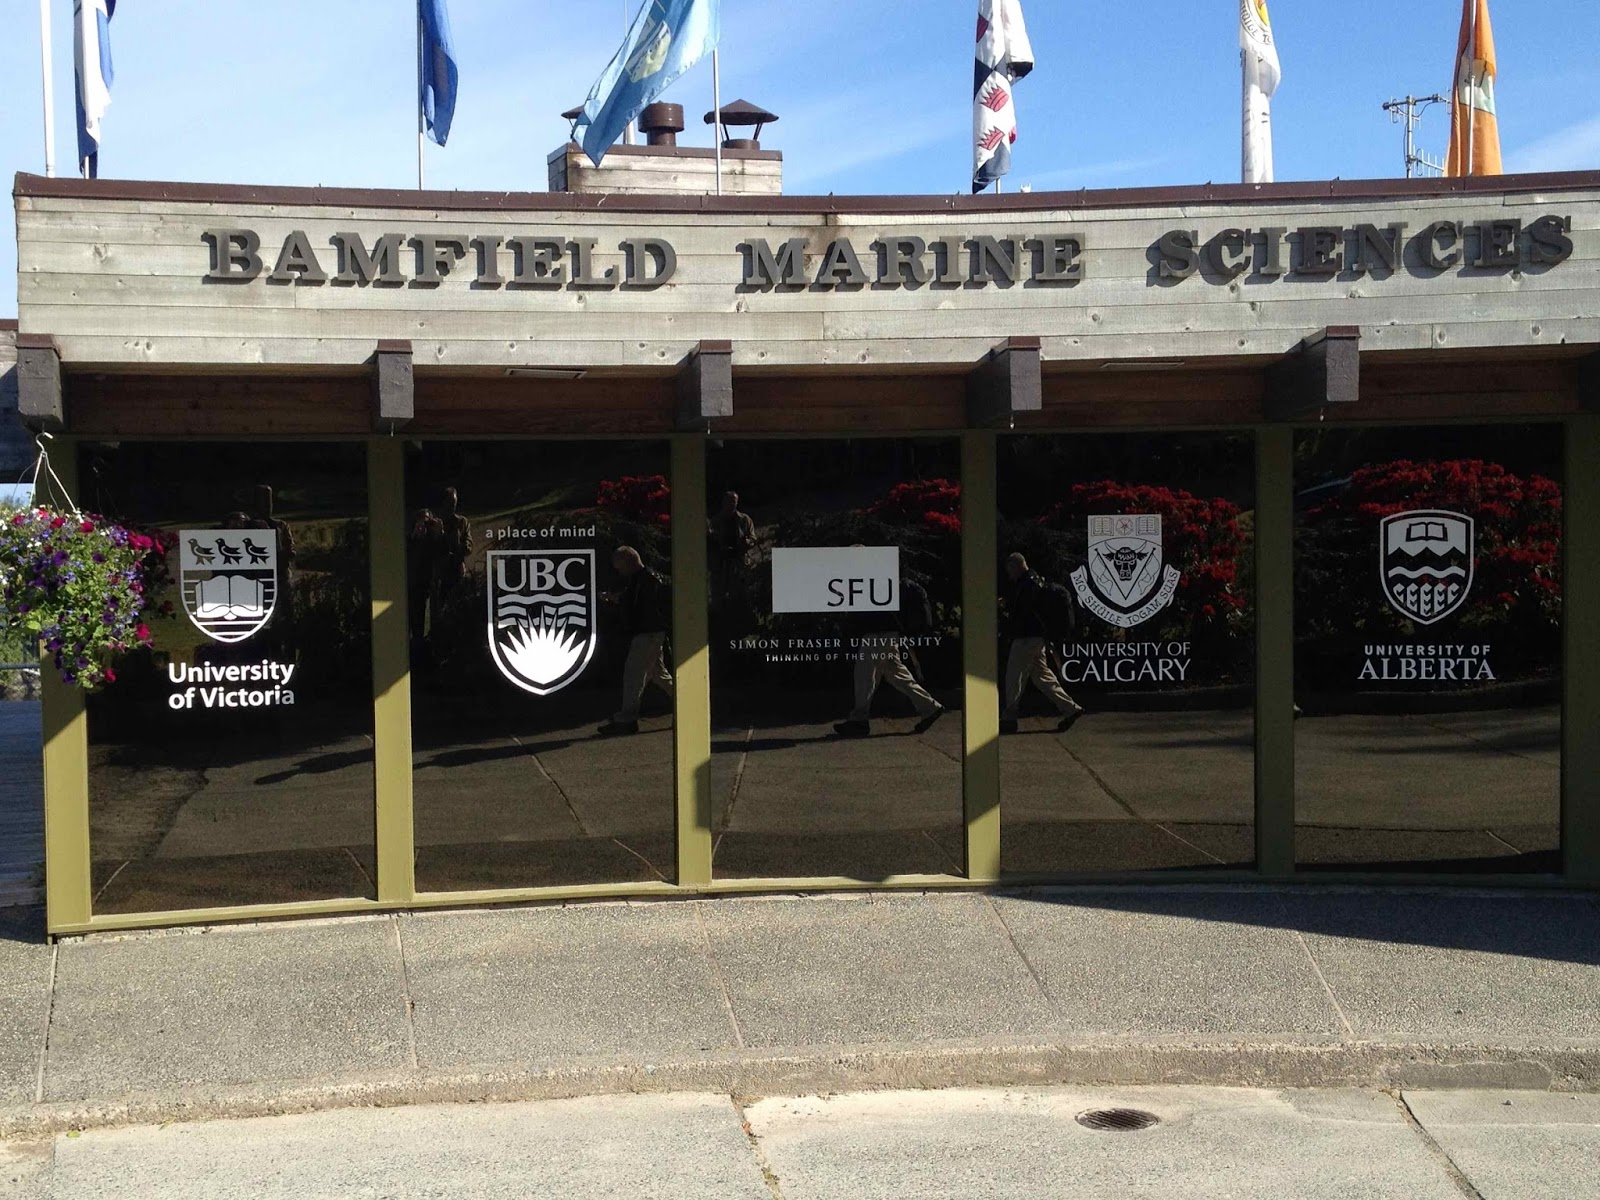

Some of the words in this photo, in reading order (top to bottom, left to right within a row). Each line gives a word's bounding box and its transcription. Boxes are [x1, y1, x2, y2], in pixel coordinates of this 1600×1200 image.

[204, 228, 678, 288] BAMFIELD
[741, 231, 1086, 287] MARINE
[1153, 213, 1573, 282] SCIENCES
[485, 529, 494, 539] a
[498, 526, 537, 540] place
[540, 525, 555, 538] of
[559, 525, 596, 537] mind
[496, 557, 586, 592] UBC
[1073, 574, 1087, 593] MO
[1159, 571, 1179, 599] SUAS
[827, 578, 893, 607] SFU
[729, 639, 779, 650] SIMON
[788, 638, 841, 649] FRASER
[850, 636, 943, 648] UNIVERSITY
[1062, 642, 1162, 658] UNIVERSITY
[1167, 641, 1191, 656] OF
[1364, 644, 1464, 656] UNIVERSITY
[1471, 644, 1491, 656] OF
[765, 653, 820, 662] THINKING
[825, 653, 839, 661] OF
[845, 652, 865, 661] THE
[870, 652, 909, 660] WORLD
[1357, 658, 1496, 680] ALBERTA
[168, 659, 295, 685] University
[1061, 658, 1191, 683] CALGARY
[168, 687, 196, 709] of
[200, 685, 295, 708] Victoria
